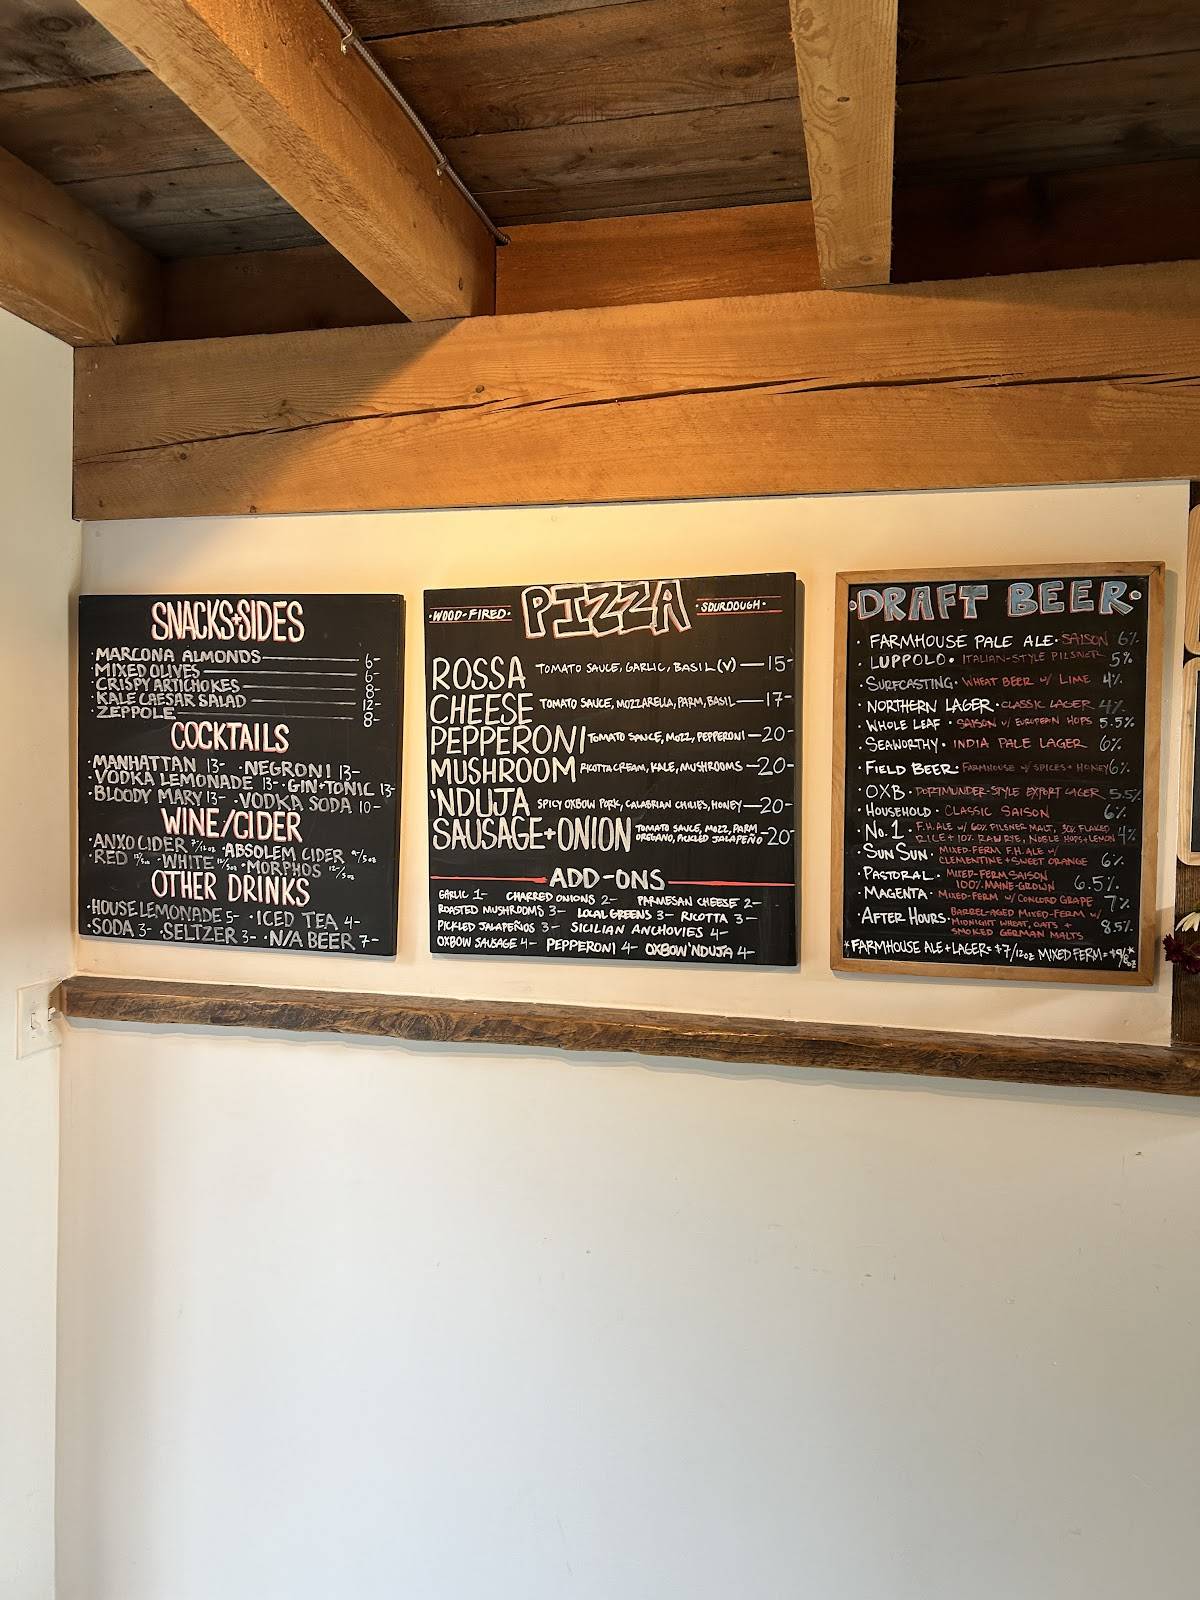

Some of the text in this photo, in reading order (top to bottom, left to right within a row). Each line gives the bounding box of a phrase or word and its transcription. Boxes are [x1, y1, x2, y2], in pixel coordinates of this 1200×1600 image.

[521, 579, 692, 639] PIZZA
[700, 600, 761, 612] SOURDOUGH
[857, 579, 1134, 621] DRAFT BEER
[151, 598, 305, 642] SNACKS+SIDES
[433, 608, 507, 621] WOOD-FIRED
[869, 630, 1140, 650] FARMHOUSE PALE ALE SAISON 6%
[95, 647, 262, 664] MARCONA ALMONDS
[870, 653, 946, 670] LUPPOLO
[1109, 651, 1133, 668] 5%
[95, 662, 200, 679] MIXED OLIVES
[432, 655, 671, 691] ROSSA TOMATO SAUCE, GARLIC,
[1002, 676, 1035, 687] BEER
[1102, 671, 1123, 688] 4%
[95, 677, 240, 693] CRISPY ARTICHOKES
[96, 691, 246, 708] KALE CAESAR SALAD
[429, 692, 534, 726] CHEESE
[539, 698, 577, 710] TOMATO
[580, 697, 613, 710] SAUCE,
[706, 696, 736, 707] BASIL
[867, 698, 938, 715] NORTHERN
[945, 698, 995, 714] LAGER
[1001, 699, 1046, 710] CLASSIC
[1050, 699, 1096, 711] LAGER
[96, 706, 176, 720] ZEPPOLE
[1099, 716, 1136, 729] 5.5%
[170, 721, 289, 753] COCKTAILS
[430, 724, 586, 756] PEPPERONI
[587, 731, 626, 743] TOMATO
[665, 731, 695, 743] MOZZ,
[696, 730, 746, 743] PEPPERONI
[953, 734, 1122, 752] INDIA PALE LAGER 6%
[92, 755, 331, 778] MANHATTAN NEGRONI
[430, 755, 743, 785] MUSHROOM KALE, MUSHROOMS
[1109, 758, 1130, 775] 6%
[94, 769, 155, 786] VODKA
[160, 772, 254, 790] LEMONADE
[94, 785, 352, 814] BLOODY MARY VODKA SODA
[865, 783, 906, 801] OXB
[1026, 786, 1063, 800] EXPORT
[429, 787, 743, 818] 'NDUJA SPICY OXBOW PORK, CALABRIAN HONEY
[1103, 803, 1127, 820] 6%
[160, 806, 302, 842] WINE/CIDER
[432, 815, 632, 852] SAUSAGE+ONION
[635, 823, 670, 833] TOMATO
[732, 823, 758, 834] PARM
[891, 819, 905, 840] 1
[93, 833, 345, 864] ANXO CIDER ABSOLEM CIDER
[676, 833, 709, 844] PICKLED
[94, 850, 321, 878] RED WHITE MORPHOS
[938, 856, 1003, 865] CLEMENTINE
[1101, 852, 1125, 868] 6%
[151, 869, 310, 907] OTHER DRINKS
[549, 867, 665, 891] ADD-ONS
[1074, 874, 1120, 892] 6.5%
[438, 889, 741, 909] GARLIC CHARRED ONIONS PARMESAN CHEESE
[1104, 895, 1130, 912] 7%
[91, 898, 339, 931] HOUSE LEMONADE ICED TEA
[437, 903, 728, 924] ROASTED MUSHROOMS LOCAL GREENS RICOTTA
[92, 917, 356, 950] SODA SELTZER N/A BEER
[437, 919, 704, 938] PICKLED JALAPEÑOS SICILIAN ANCHOVIES
[951, 927, 1084, 940] SMOKED GERMAN MALTS
[1100, 919, 1134, 934] 8.5%
[436, 935, 472, 949] OXBOW
[474, 937, 518, 949] SAUSAGE
[546, 937, 616, 955] PEPPERONI
[645, 942, 688, 957] OXBOW
[1037, 948, 1071, 962] MIXED
